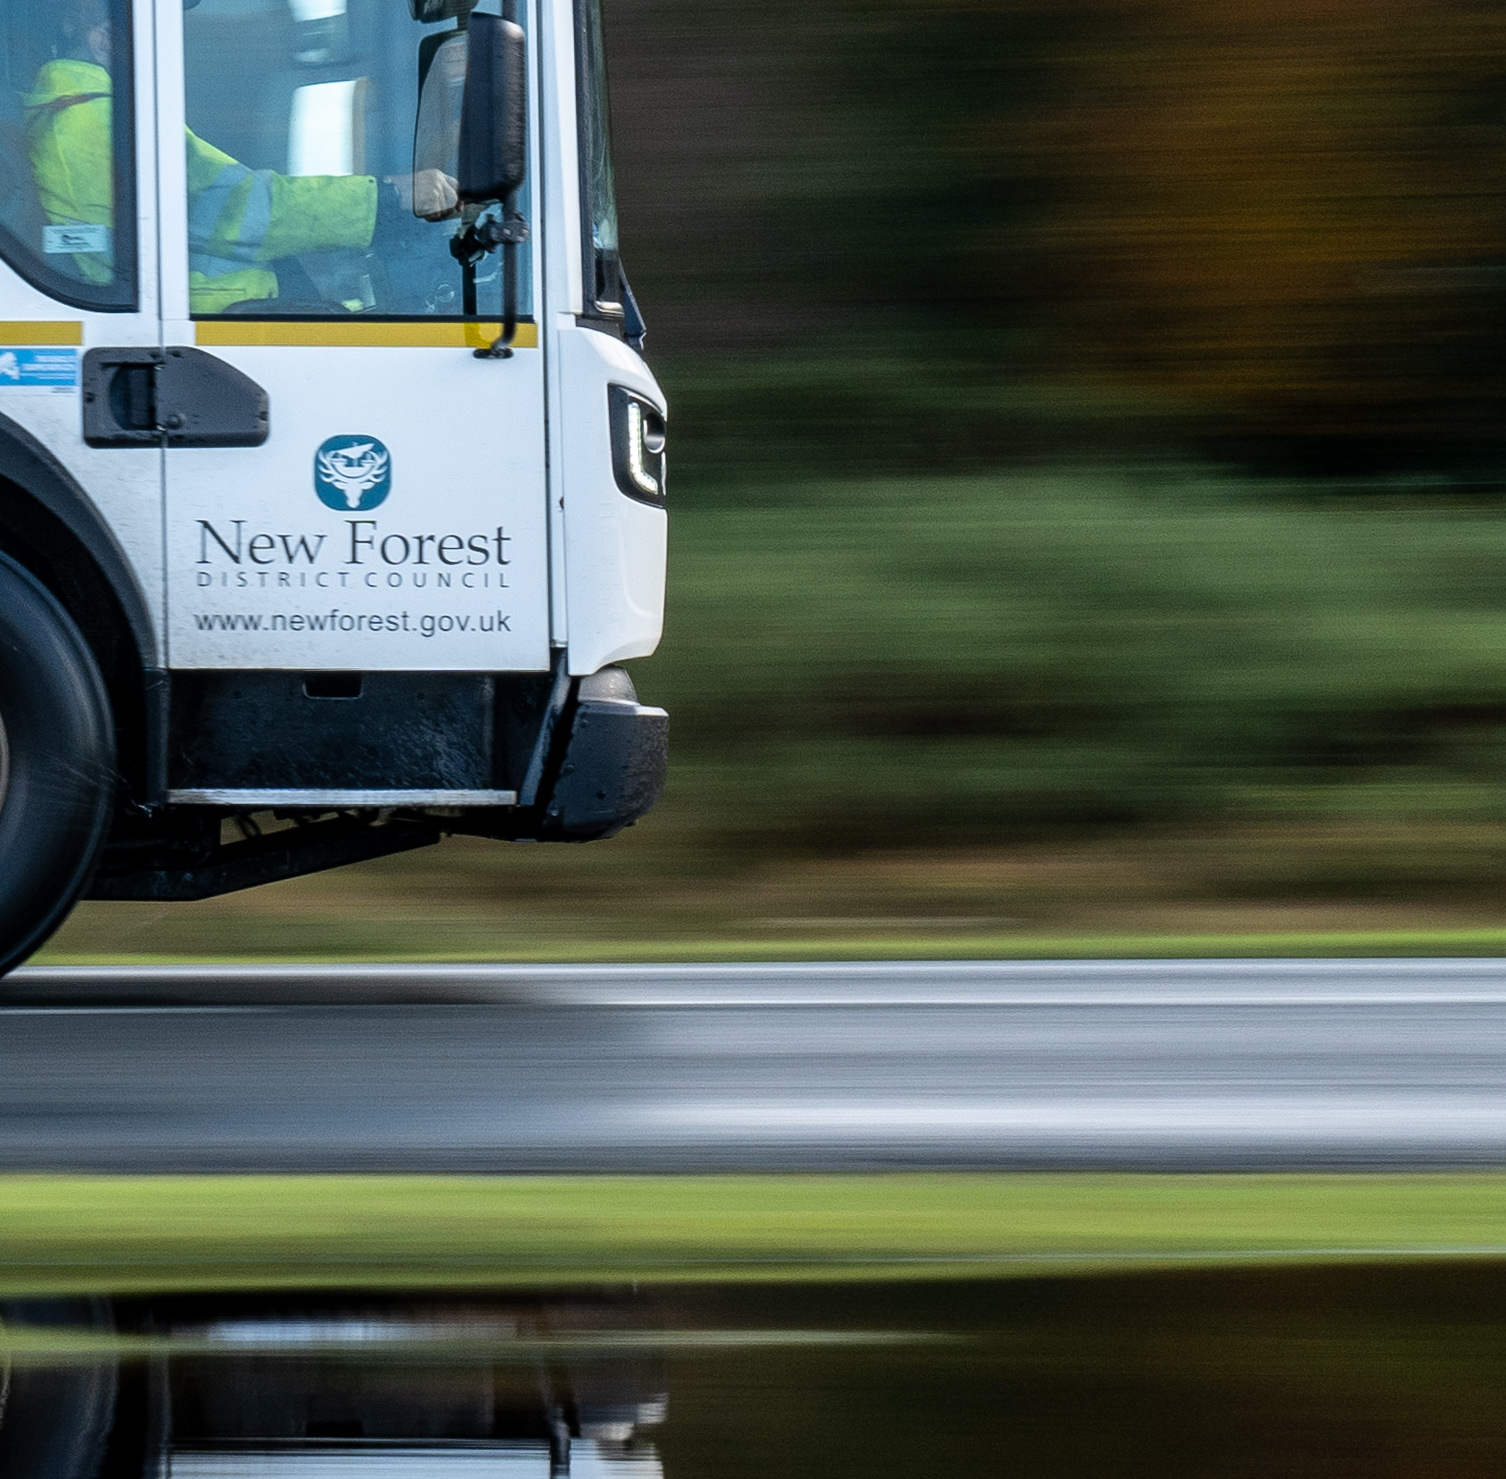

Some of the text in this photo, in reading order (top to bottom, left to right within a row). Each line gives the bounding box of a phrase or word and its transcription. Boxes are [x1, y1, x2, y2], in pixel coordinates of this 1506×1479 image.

[195, 520, 512, 565] New Forest
[196, 572, 511, 588] DISTRICT COUNCIL
[193, 609, 512, 637] www.newforest.gov.uk
